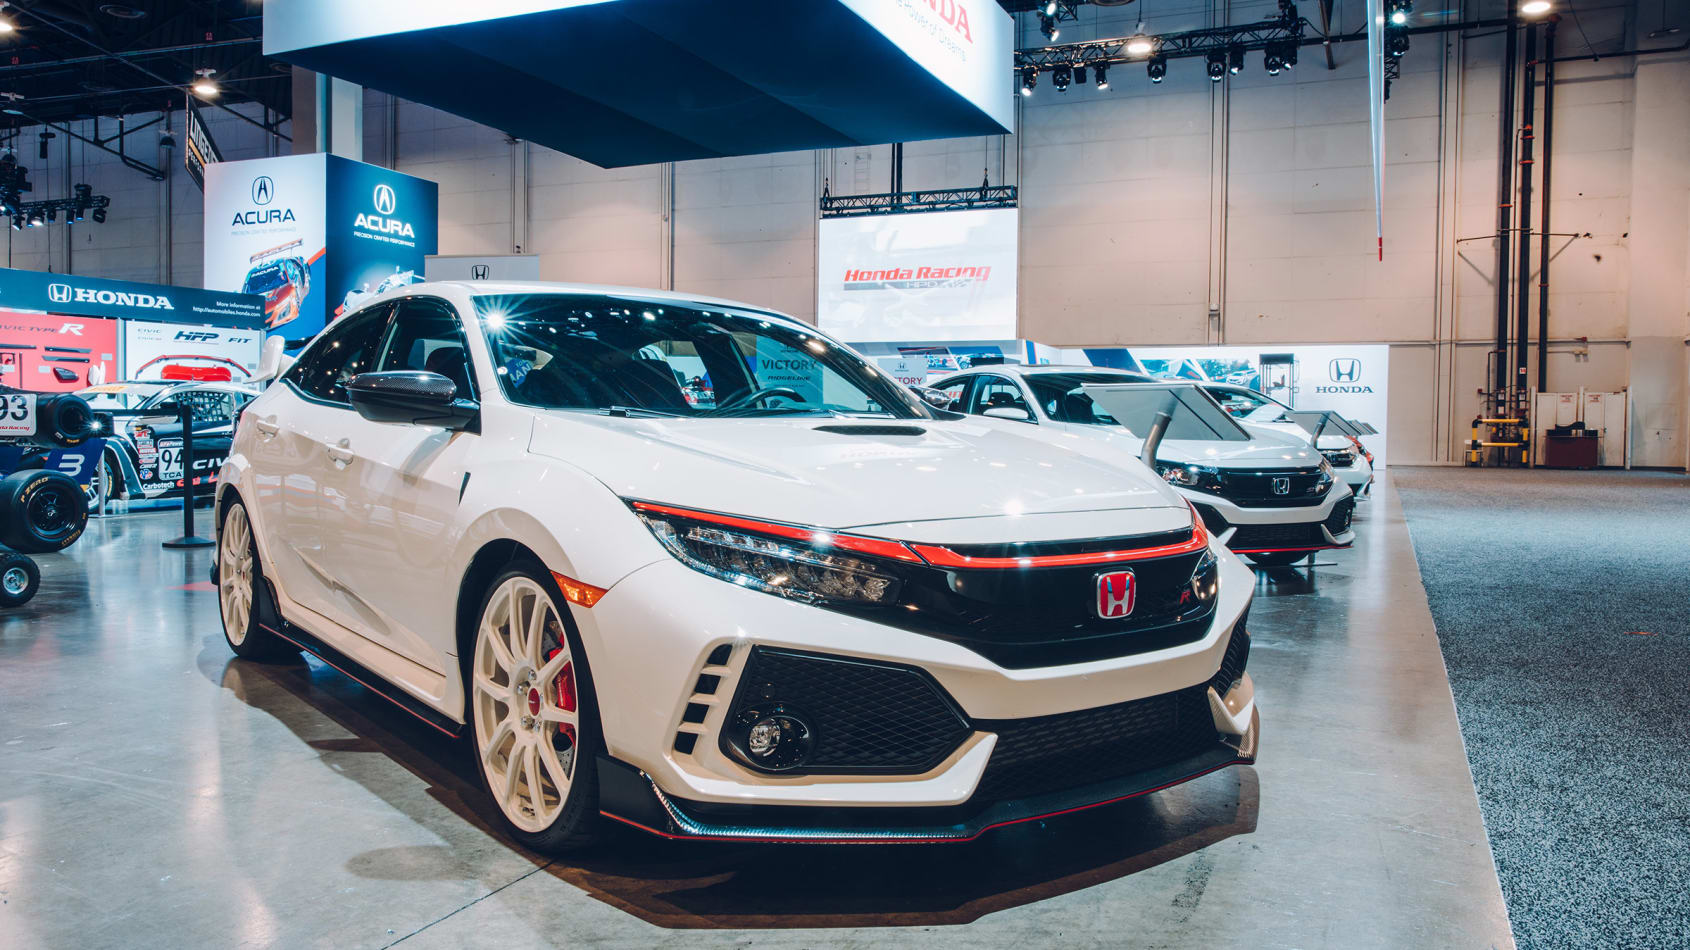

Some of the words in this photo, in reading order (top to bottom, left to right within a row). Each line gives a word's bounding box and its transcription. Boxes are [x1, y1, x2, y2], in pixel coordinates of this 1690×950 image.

[232, 208, 296, 226] ACURA
[354, 213, 415, 238] ACURA
[844, 268, 913, 282] Honda
[916, 266, 992, 282] Racing
[74, 288, 175, 310] HONDA
[229, 302, 255, 310] information
[58, 322, 85, 336] R
[174, 330, 220, 342] HFP
[762, 359, 817, 370] VICTORY
[161, 449, 184, 472] 94
[163, 471, 182, 479] TCA
[25, 476, 49, 495] ZERO
[143, 481, 175, 490] Carbotech
[1179, 590, 1192, 605] R
